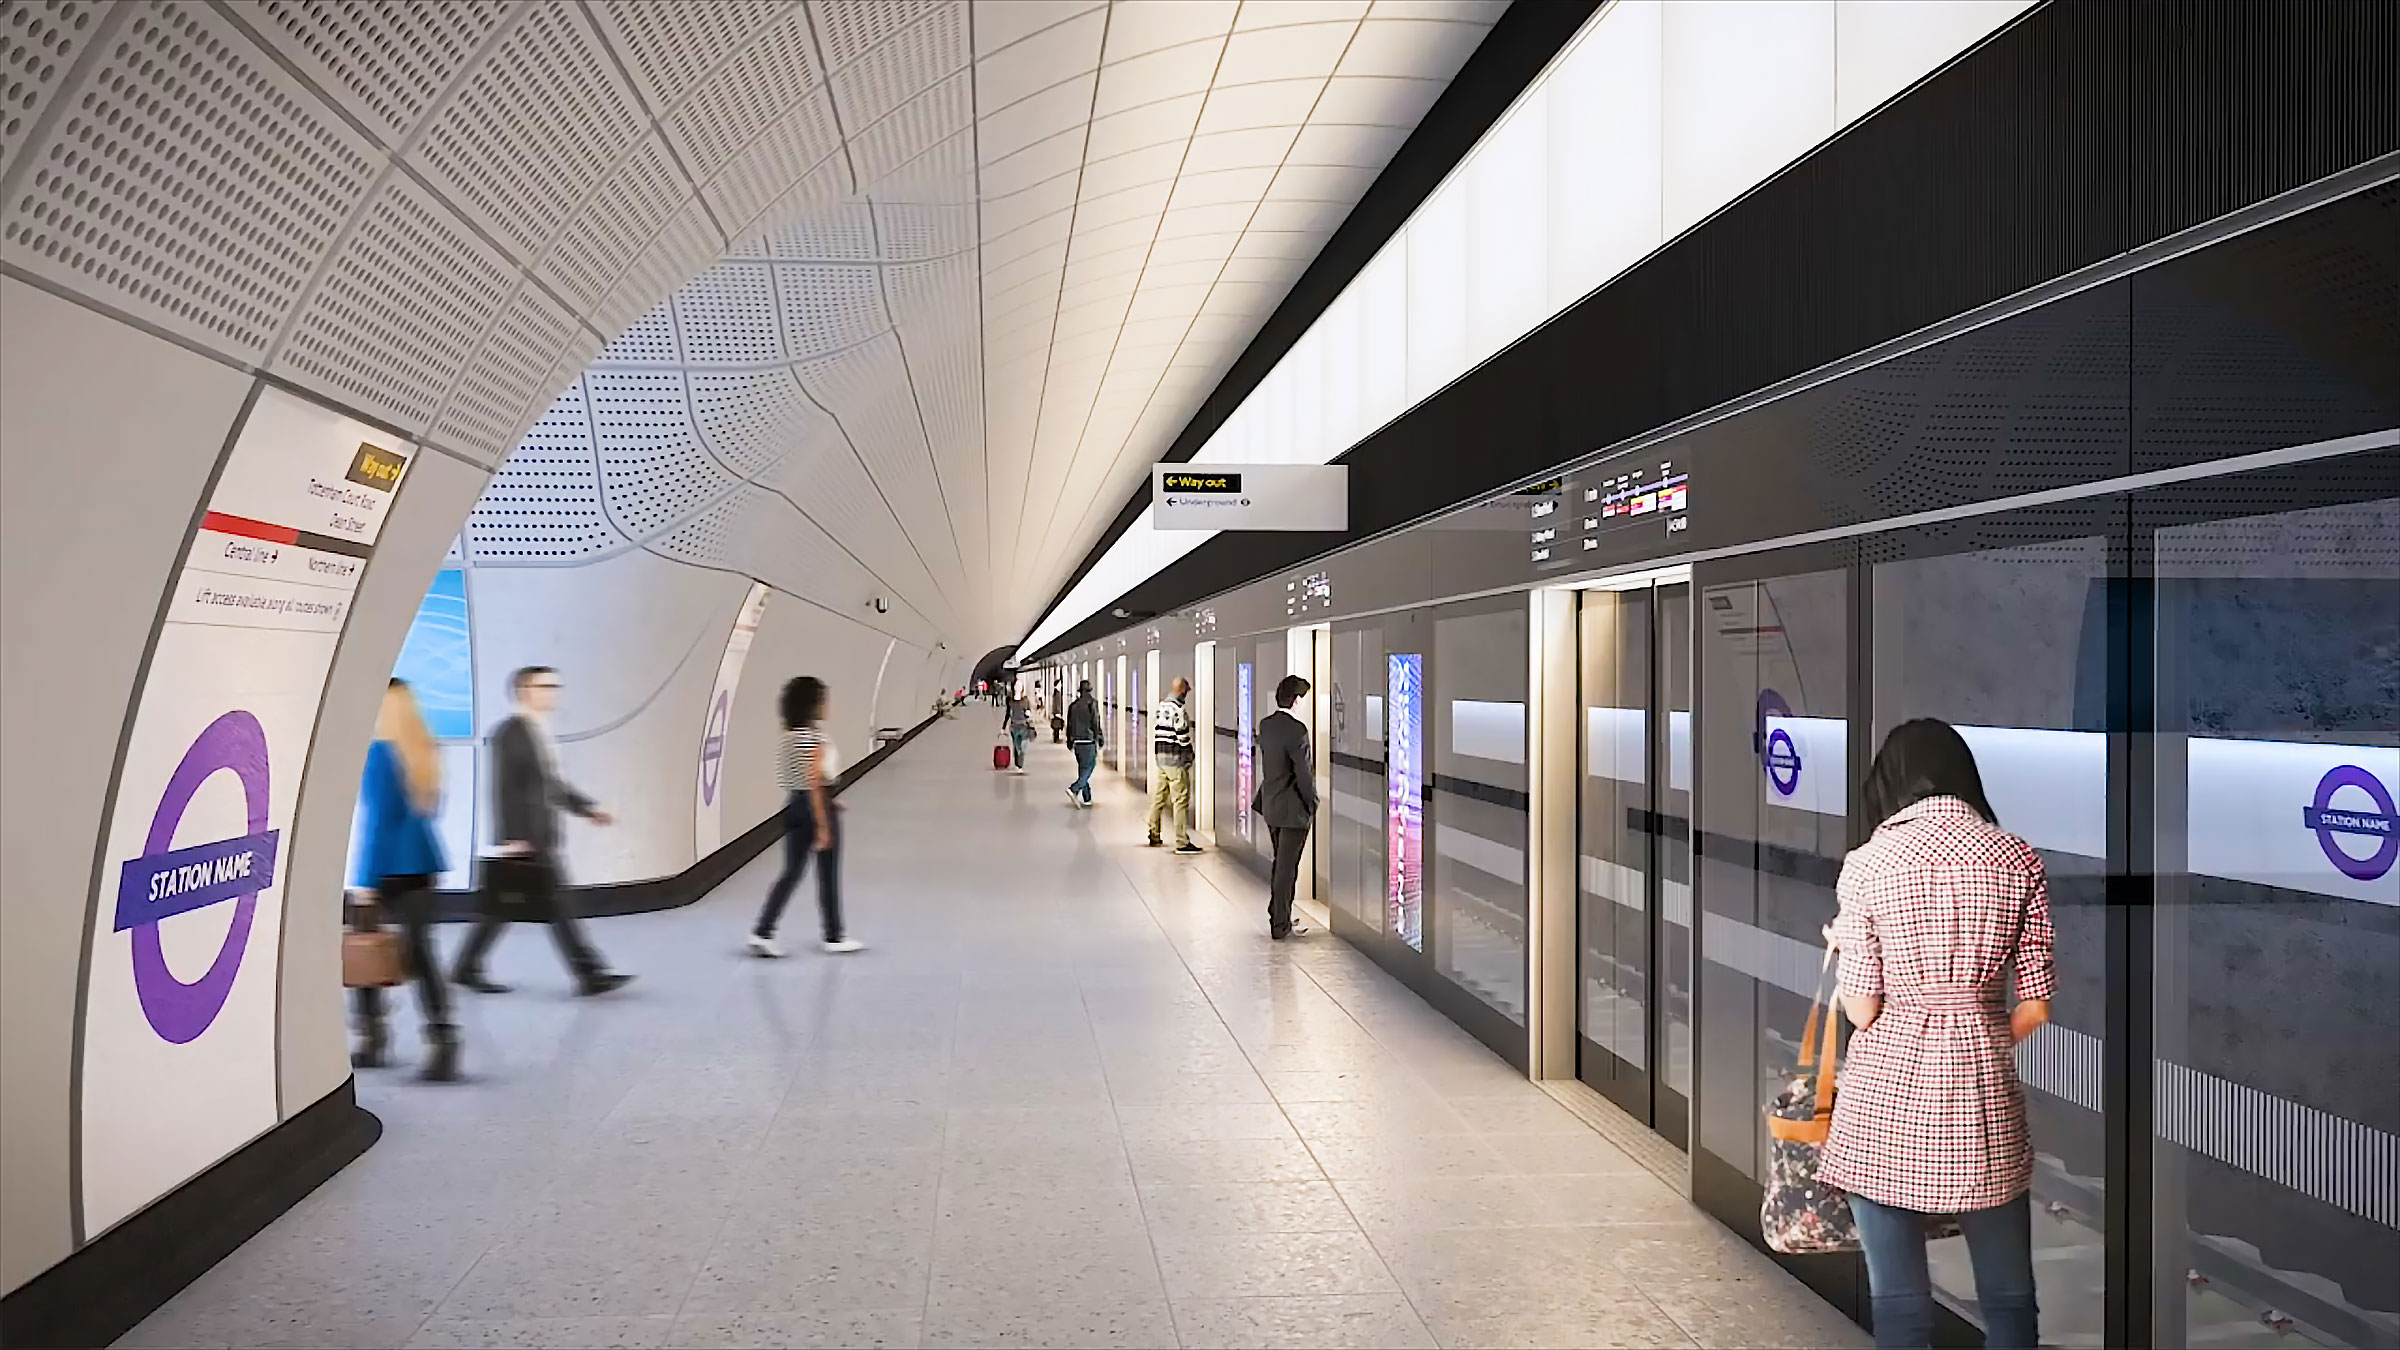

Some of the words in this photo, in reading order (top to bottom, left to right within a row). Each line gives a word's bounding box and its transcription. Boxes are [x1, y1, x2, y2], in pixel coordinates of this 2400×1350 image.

[360, 453, 378, 479] Way
[1178, 476, 1204, 490] Way
[1205, 477, 1226, 488] out
[1179, 497, 1238, 507] Underground
[224, 541, 253, 561] Central
[149, 859, 213, 902] STATION
[213, 851, 254, 885] NAME
